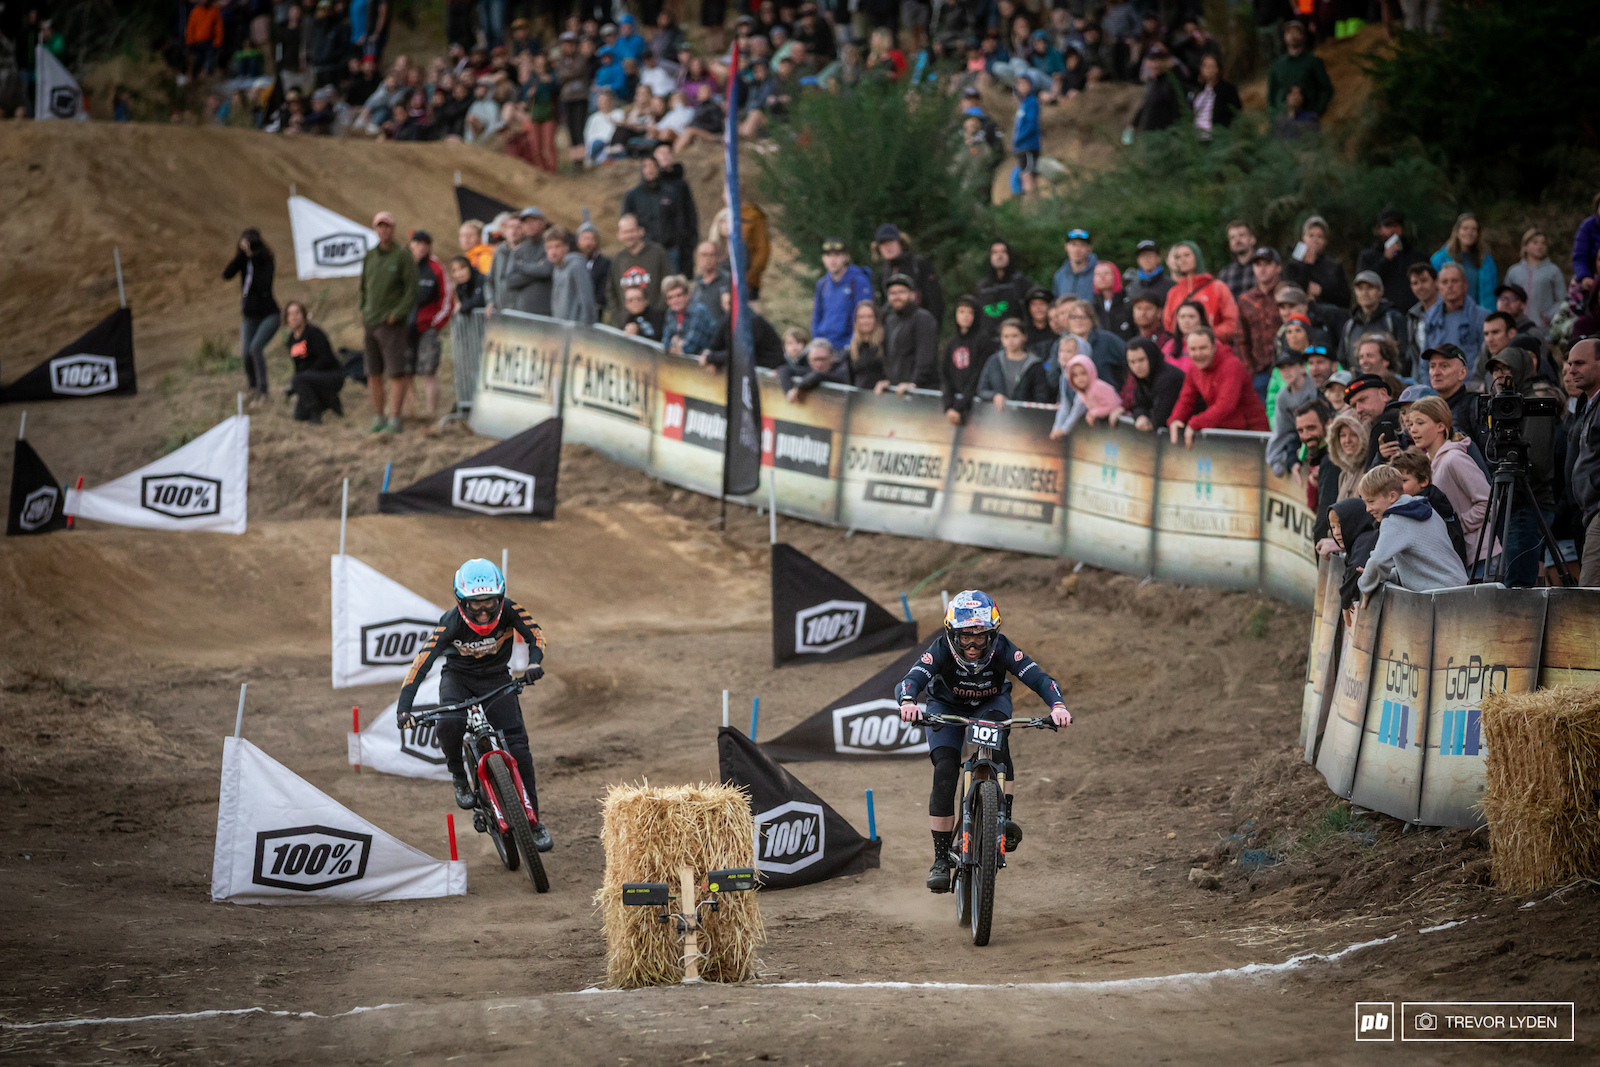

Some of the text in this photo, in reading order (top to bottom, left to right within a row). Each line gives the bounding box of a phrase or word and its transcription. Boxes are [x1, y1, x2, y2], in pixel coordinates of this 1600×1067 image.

[61, 363, 108, 387] 100%
[870, 451, 944, 480] TRANSDIESEL
[976, 462, 1060, 494] TRANSDIESEL
[153, 484, 211, 508] 100%
[464, 478, 524, 507] 100%
[1267, 498, 1315, 541] PIVO
[806, 611, 858, 644] 100%
[1386, 649, 1420, 698] GoPro
[1445, 655, 1508, 701] GoPro
[848, 714, 922, 747] 100%
[972, 725, 999, 743] 101
[764, 816, 817, 858] 100%
[270, 843, 356, 876] 100%
